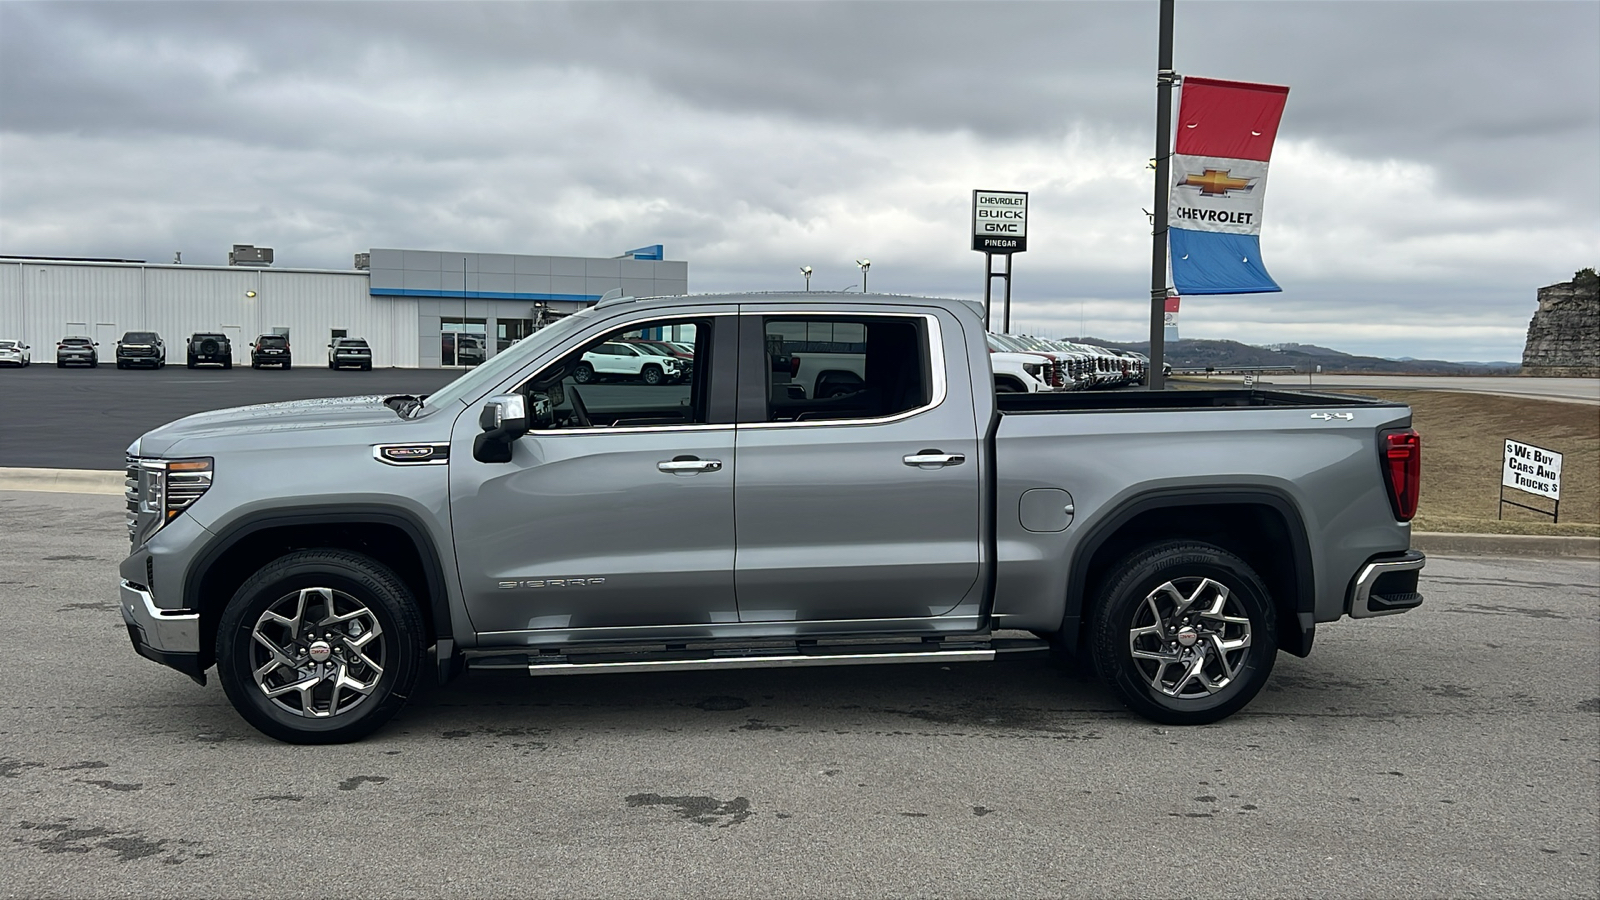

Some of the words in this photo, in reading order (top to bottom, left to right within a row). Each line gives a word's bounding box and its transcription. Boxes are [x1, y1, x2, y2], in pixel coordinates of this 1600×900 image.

[980, 196, 1024, 206] CHEVROLET
[978, 209, 1024, 220] BUICK
[1176, 206, 1253, 225] CHEVROLET
[984, 223, 1018, 232] GMC
[984, 238, 1017, 247] PINEGAR
[498, 577, 606, 590] SIERRA
